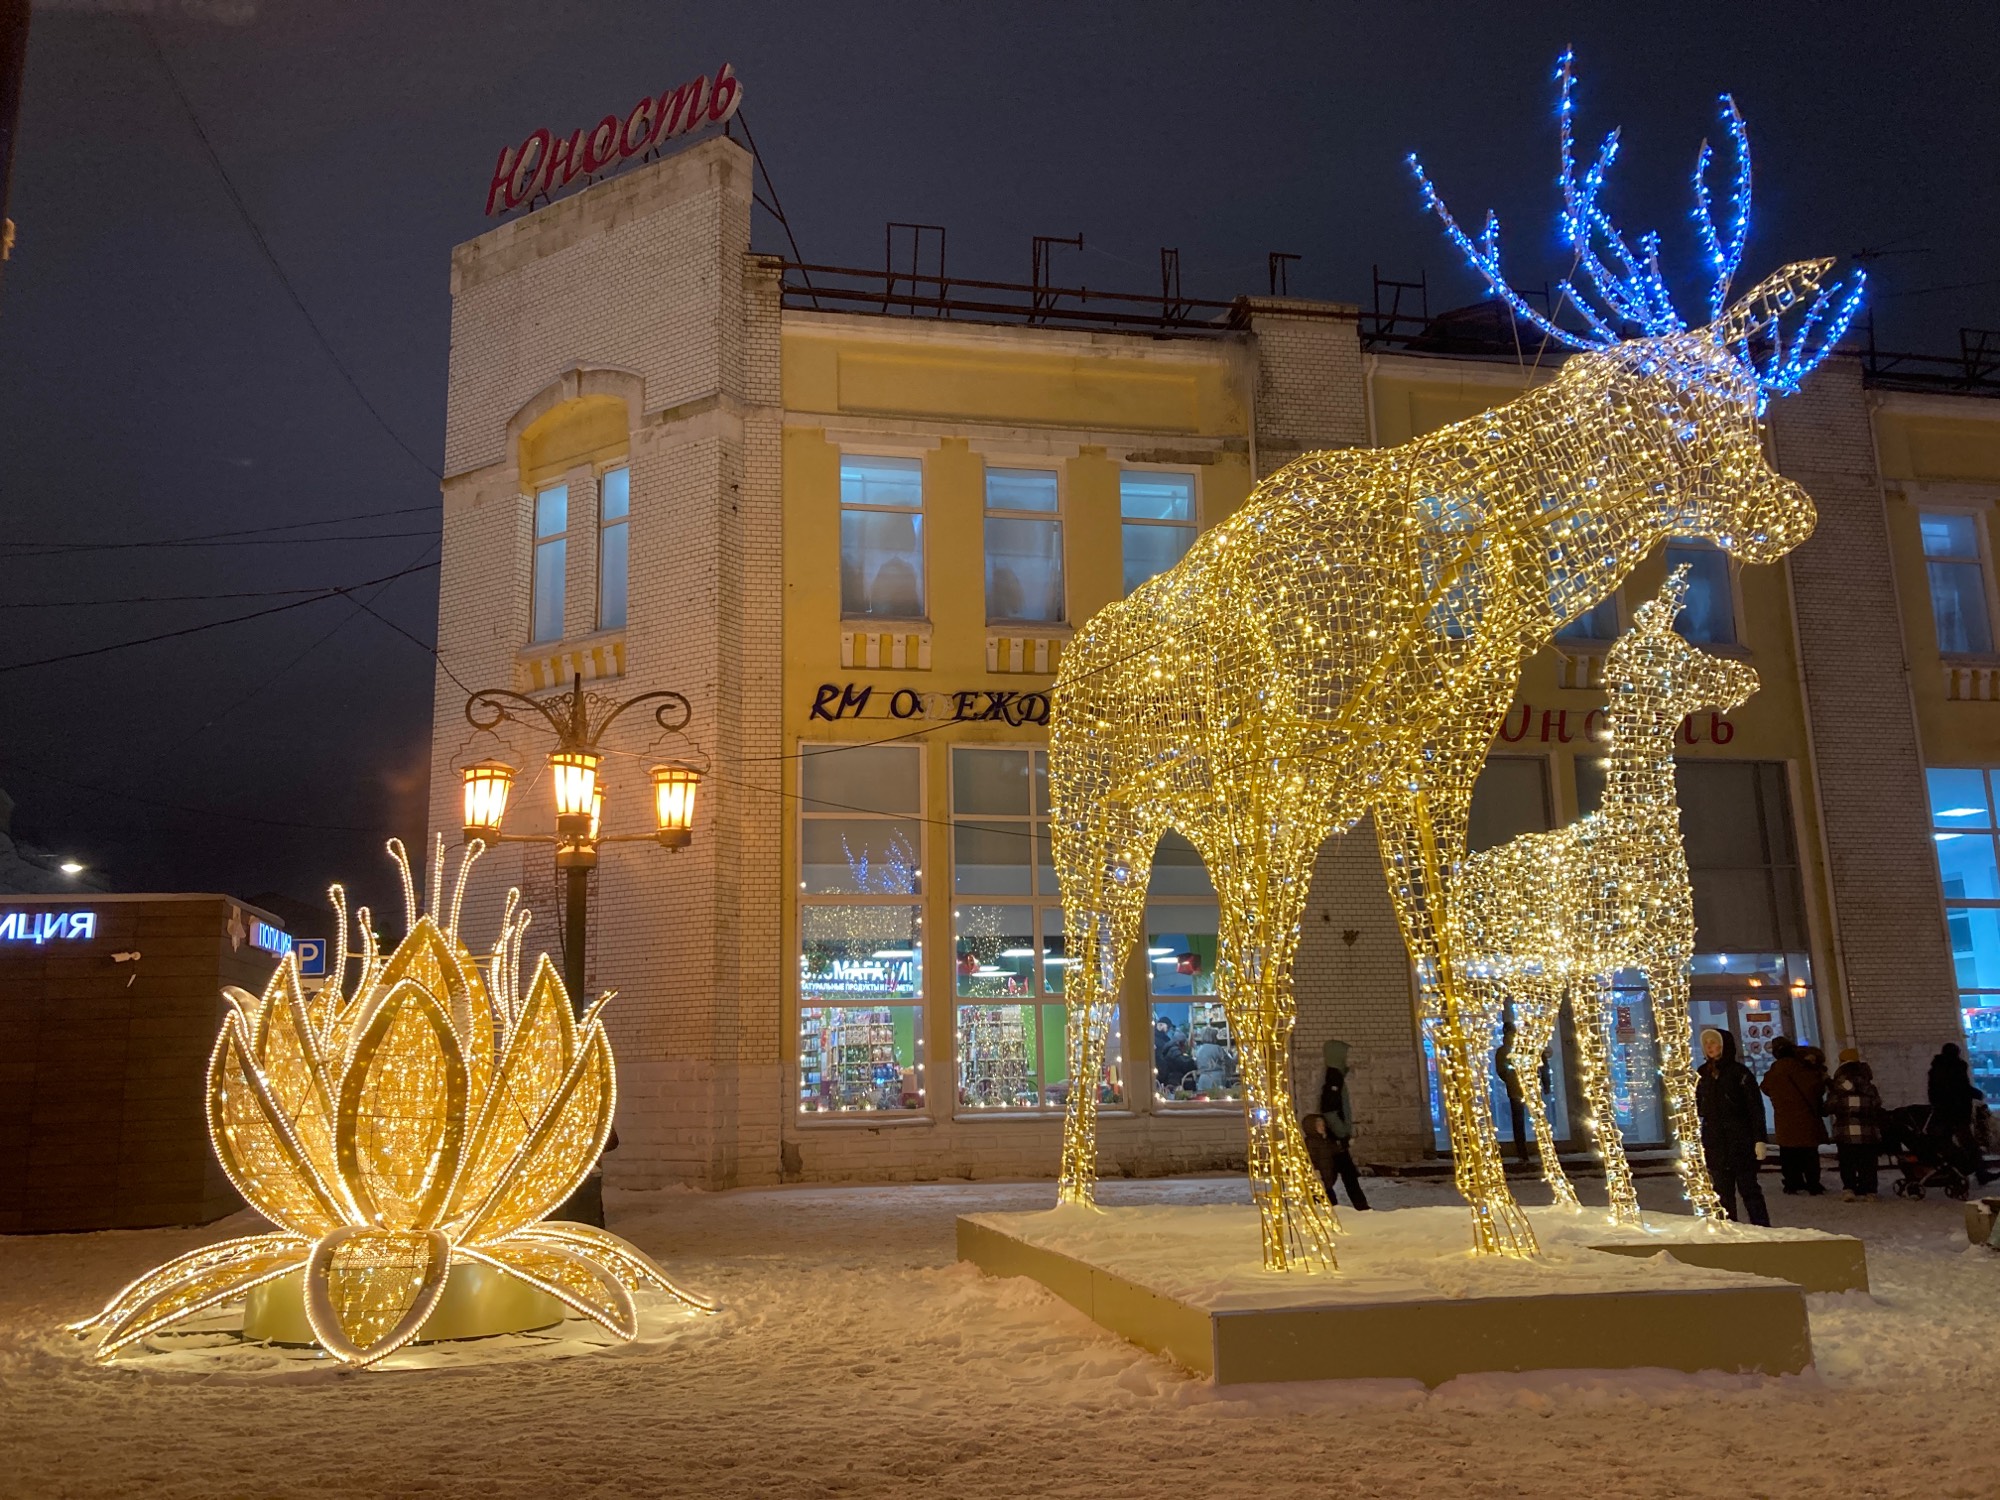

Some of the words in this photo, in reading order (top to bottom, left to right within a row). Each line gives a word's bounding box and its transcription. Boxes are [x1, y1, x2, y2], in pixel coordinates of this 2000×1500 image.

[485, 62, 742, 216] Юность
[809, 683, 872, 722] RM
[259, 922, 292, 957] ПОЛИЦИЯ
[298, 943, 319, 971] P
